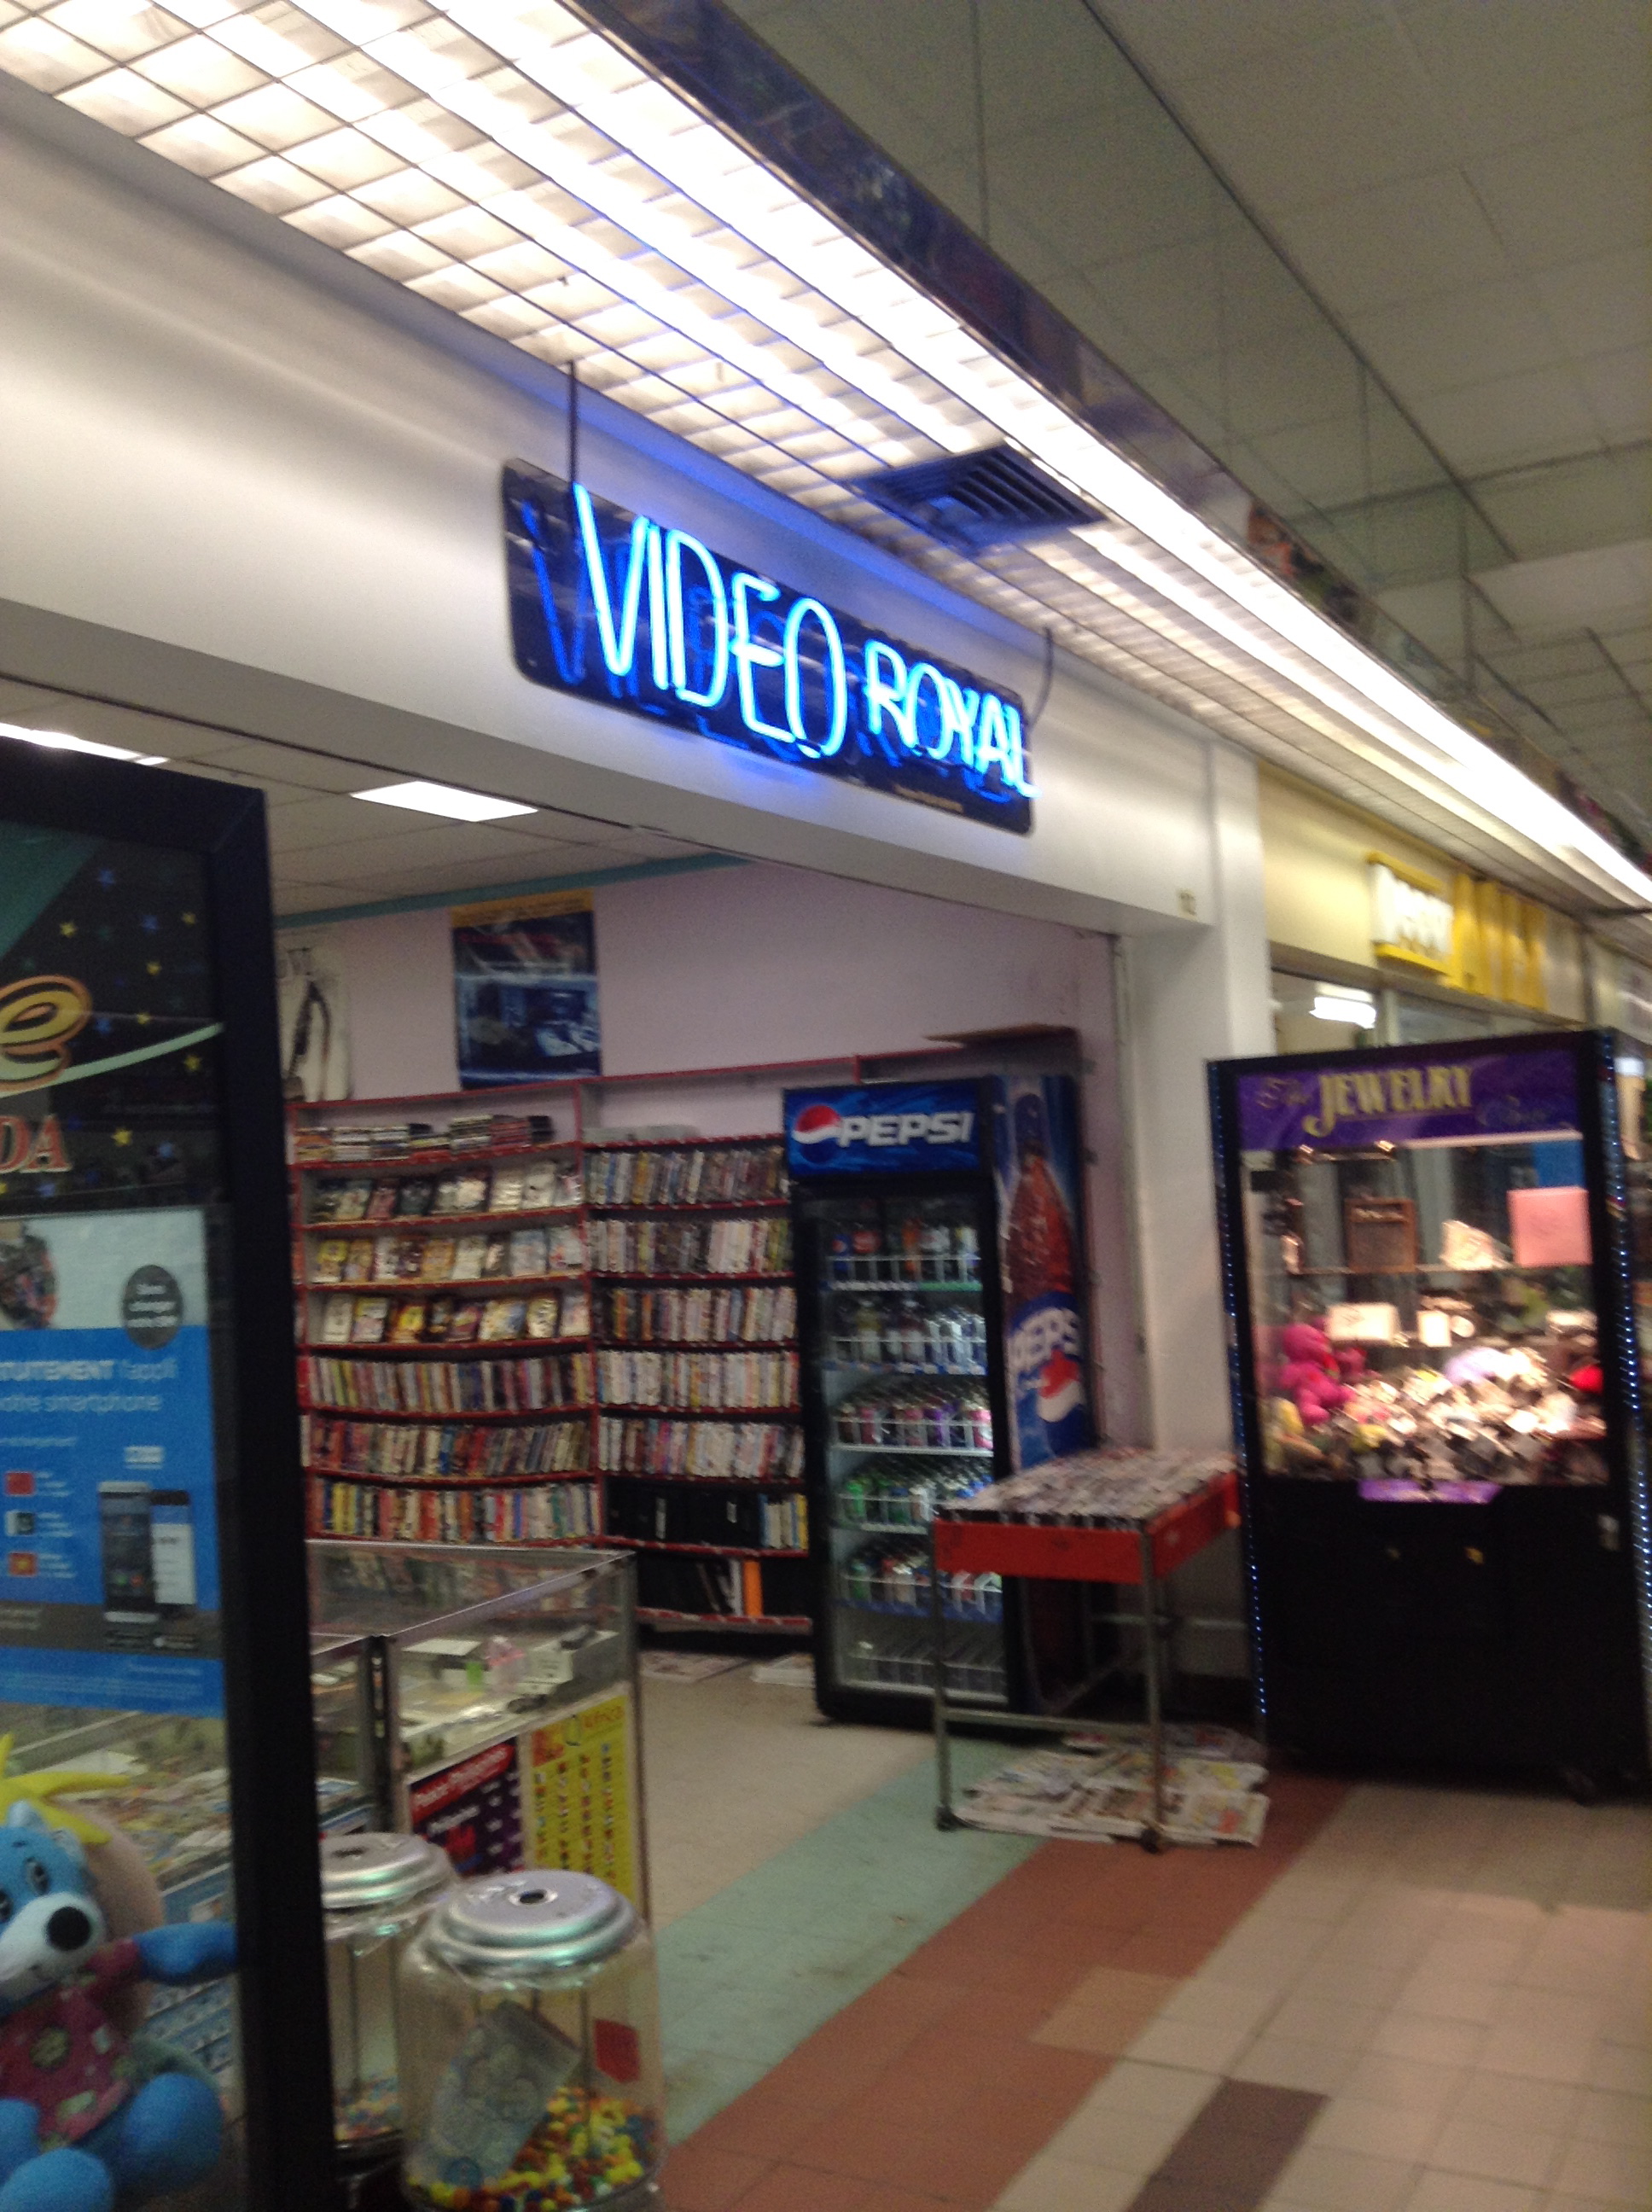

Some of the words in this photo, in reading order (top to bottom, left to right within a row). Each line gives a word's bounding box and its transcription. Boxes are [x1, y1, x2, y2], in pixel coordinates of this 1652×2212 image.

[573, 481, 846, 758] VIDEO
[864, 637, 1042, 799] ROYAL
[841, 1111, 974, 1147] PEPSI
[1302, 1065, 1474, 1137] JEWELRY
